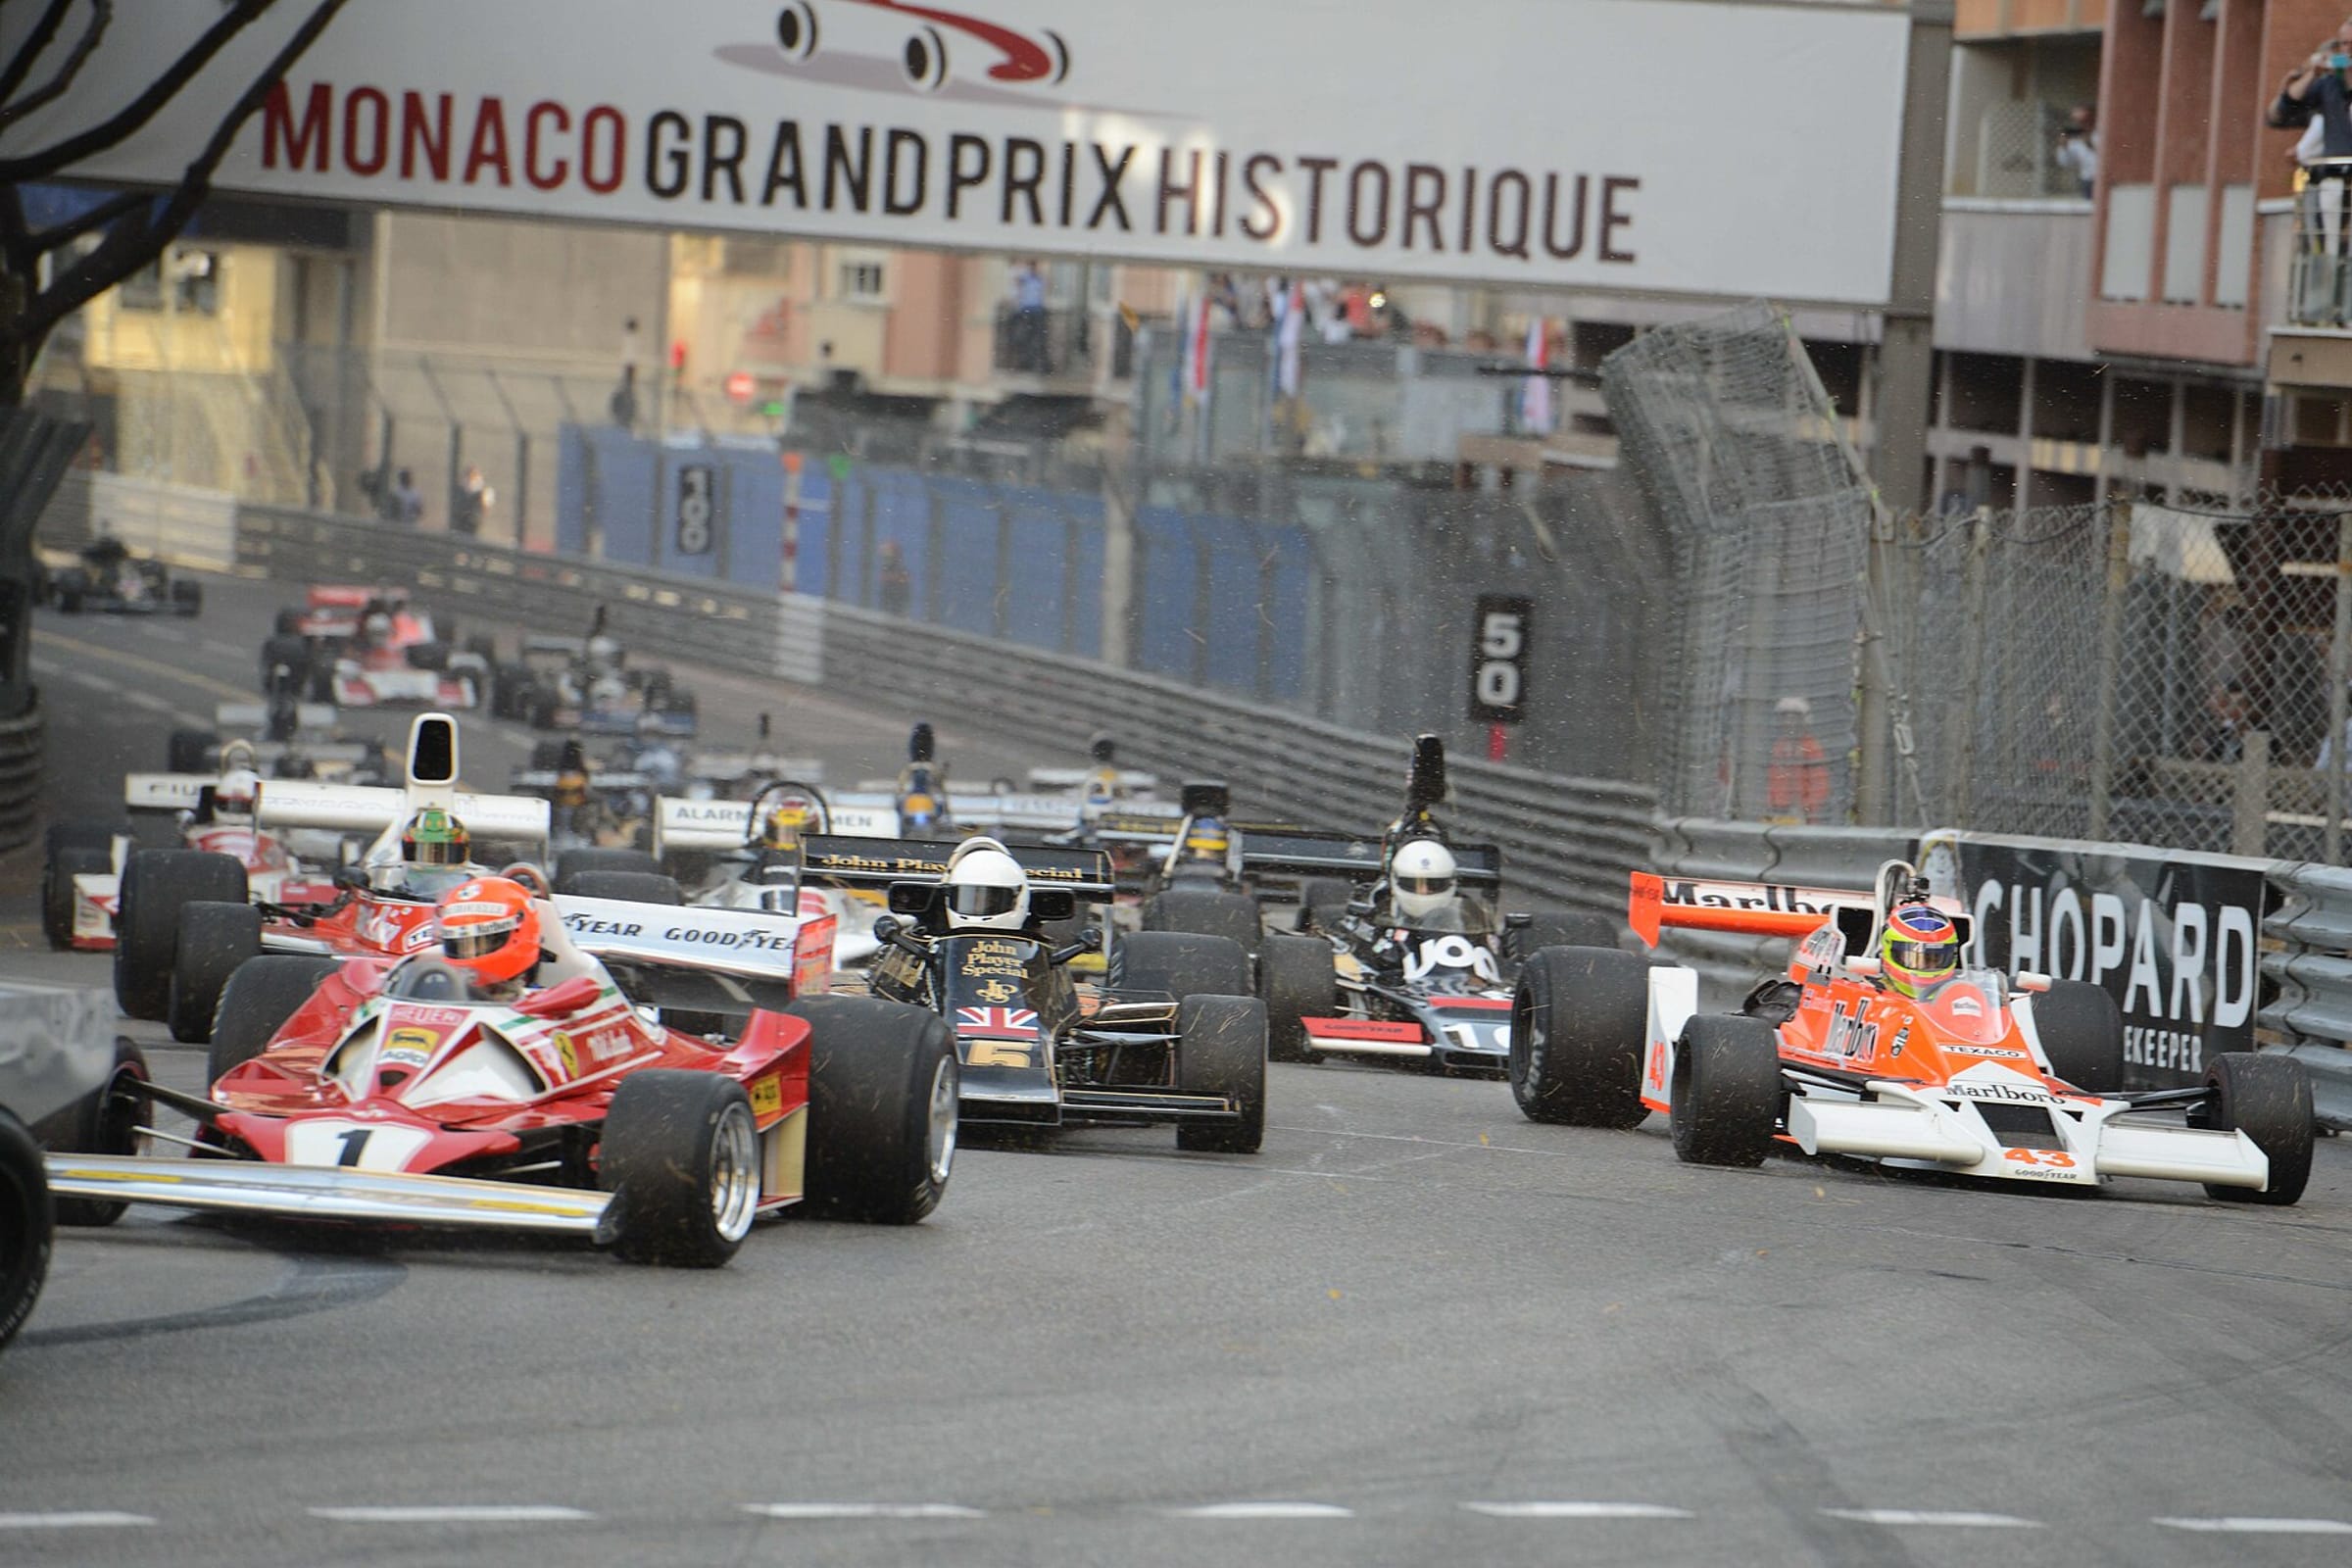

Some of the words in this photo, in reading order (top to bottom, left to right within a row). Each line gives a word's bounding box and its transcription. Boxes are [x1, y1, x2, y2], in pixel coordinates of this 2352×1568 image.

[262, 81, 627, 195] MONACO
[644, 110, 929, 217] GRAND
[945, 133, 1136, 232] PRIX
[1153, 145, 1642, 264] HISTORIQUE
[1477, 612, 1521, 707] 50
[821, 855, 888, 869] John
[897, 858, 949, 873] Play
[1024, 866, 1083, 880] ecial
[1663, 881, 1838, 914] Marlb
[572, 915, 642, 937] YEAR
[664, 927, 796, 951] GOODYE
[967, 954, 1025, 967] Player
[971, 942, 1017, 955] John
[1974, 878, 2254, 1029] CHOPARD
[961, 965, 1028, 979] Special
[966, 1040, 1032, 1068] 5
[1946, 1046, 2021, 1057] TEXACO
[2123, 1025, 2203, 1074] EKEEPER
[1946, 1084, 2066, 1104] Marlboro
[337, 1129, 375, 1166] 1
[2004, 1148, 2076, 1168] 43
